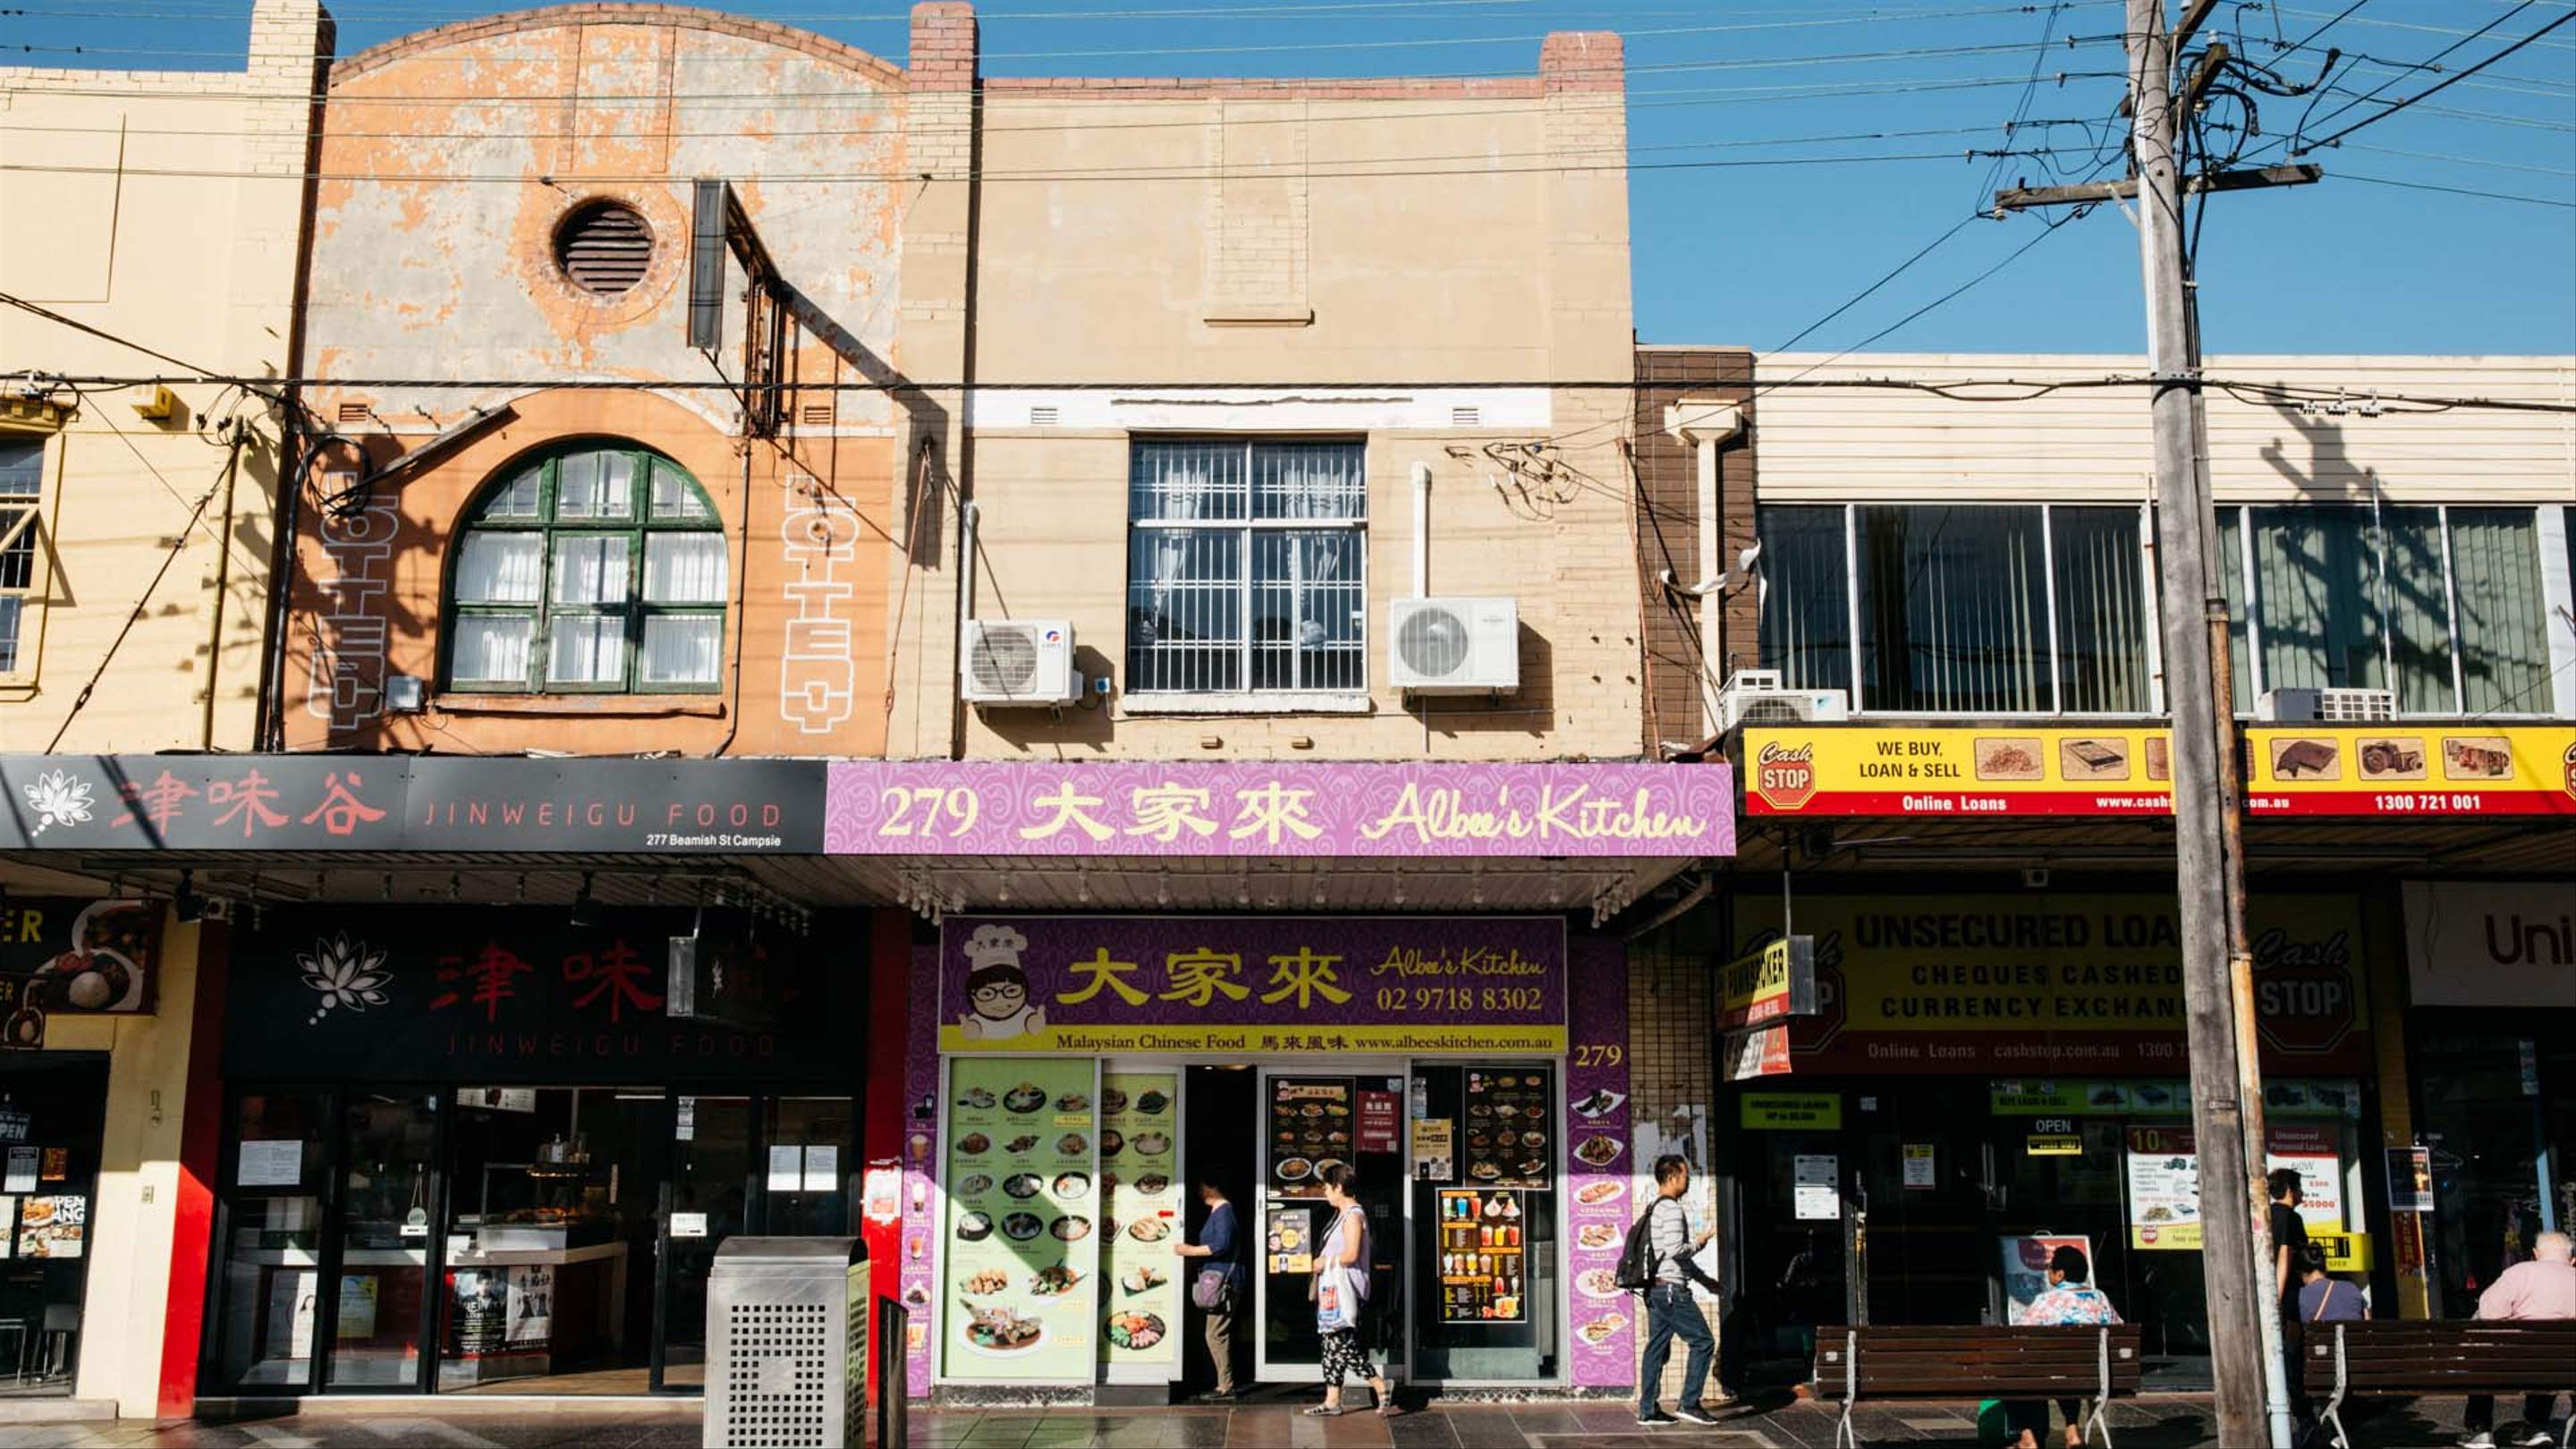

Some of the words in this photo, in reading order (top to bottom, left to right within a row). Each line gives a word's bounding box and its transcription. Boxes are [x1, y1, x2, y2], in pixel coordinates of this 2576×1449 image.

[1759, 741, 1814, 766] Cash
[1877, 741, 1903, 757] WE
[1909, 741, 1944, 758] BUY,
[1764, 767, 1809, 790] STOP
[1860, 764, 1902, 778] LOAN
[1909, 764, 1919, 778] &
[1924, 764, 1961, 778] SELL
[111, 768, 386, 837] 津味谷
[877, 786, 980, 837] 279
[1019, 781, 1323, 844] 大家來
[1360, 783, 1532, 844] Albee's
[1534, 784, 1707, 839] Kitchen
[1902, 795, 1953, 811] Online
[1961, 795, 2007, 811] Loans
[2375, 795, 2414, 810] 1300
[2419, 795, 2448, 810] 721
[2453, 795, 2480, 810] 001
[425, 803, 635, 826] JINWEIGU
[668, 803, 781, 826] FOOD
[646, 835, 667, 846] 277
[669, 834, 717, 846] Beamish
[719, 834, 732, 846] St
[733, 834, 782, 848] Campsie
[1856, 915, 2089, 948] UNSECURED
[2103, 915, 2178, 948] LOA
[2485, 916, 2574, 965] Uni
[2253, 928, 2350, 970] Cash
[1369, 945, 1455, 977] Albee's
[1457, 946, 1547, 976] Kitchen
[1056, 946, 1353, 1010] 大家來
[1912, 965, 2047, 985] CHEQUES
[2062, 965, 2181, 985] CASHED
[1377, 988, 1407, 1011] 02
[1416, 988, 1473, 1011] 9718
[1482, 988, 1542, 1011] 8302
[1882, 997, 2043, 1018] CURRENCY
[2056, 997, 2186, 1018] EXCHAN
[2260, 980, 2342, 1017] STOP
[1057, 1035, 1135, 1052] Malaysian
[1139, 1035, 1204, 1049] Chinese
[1207, 1035, 1246, 1049] Food
[1260, 1035, 1350, 1051] 馬來風味
[1355, 1036, 1553, 1050] www.albeeskitchen.com.au
[1868, 1042, 1920, 1060] Online
[1928, 1042, 1976, 1060] Loans
[1995, 1042, 2120, 1063] cashstop.com.au
[1575, 1045, 1623, 1067] 279
[0, 1124, 27, 1140] PEN
[2035, 1118, 2072, 1133] OPEN
